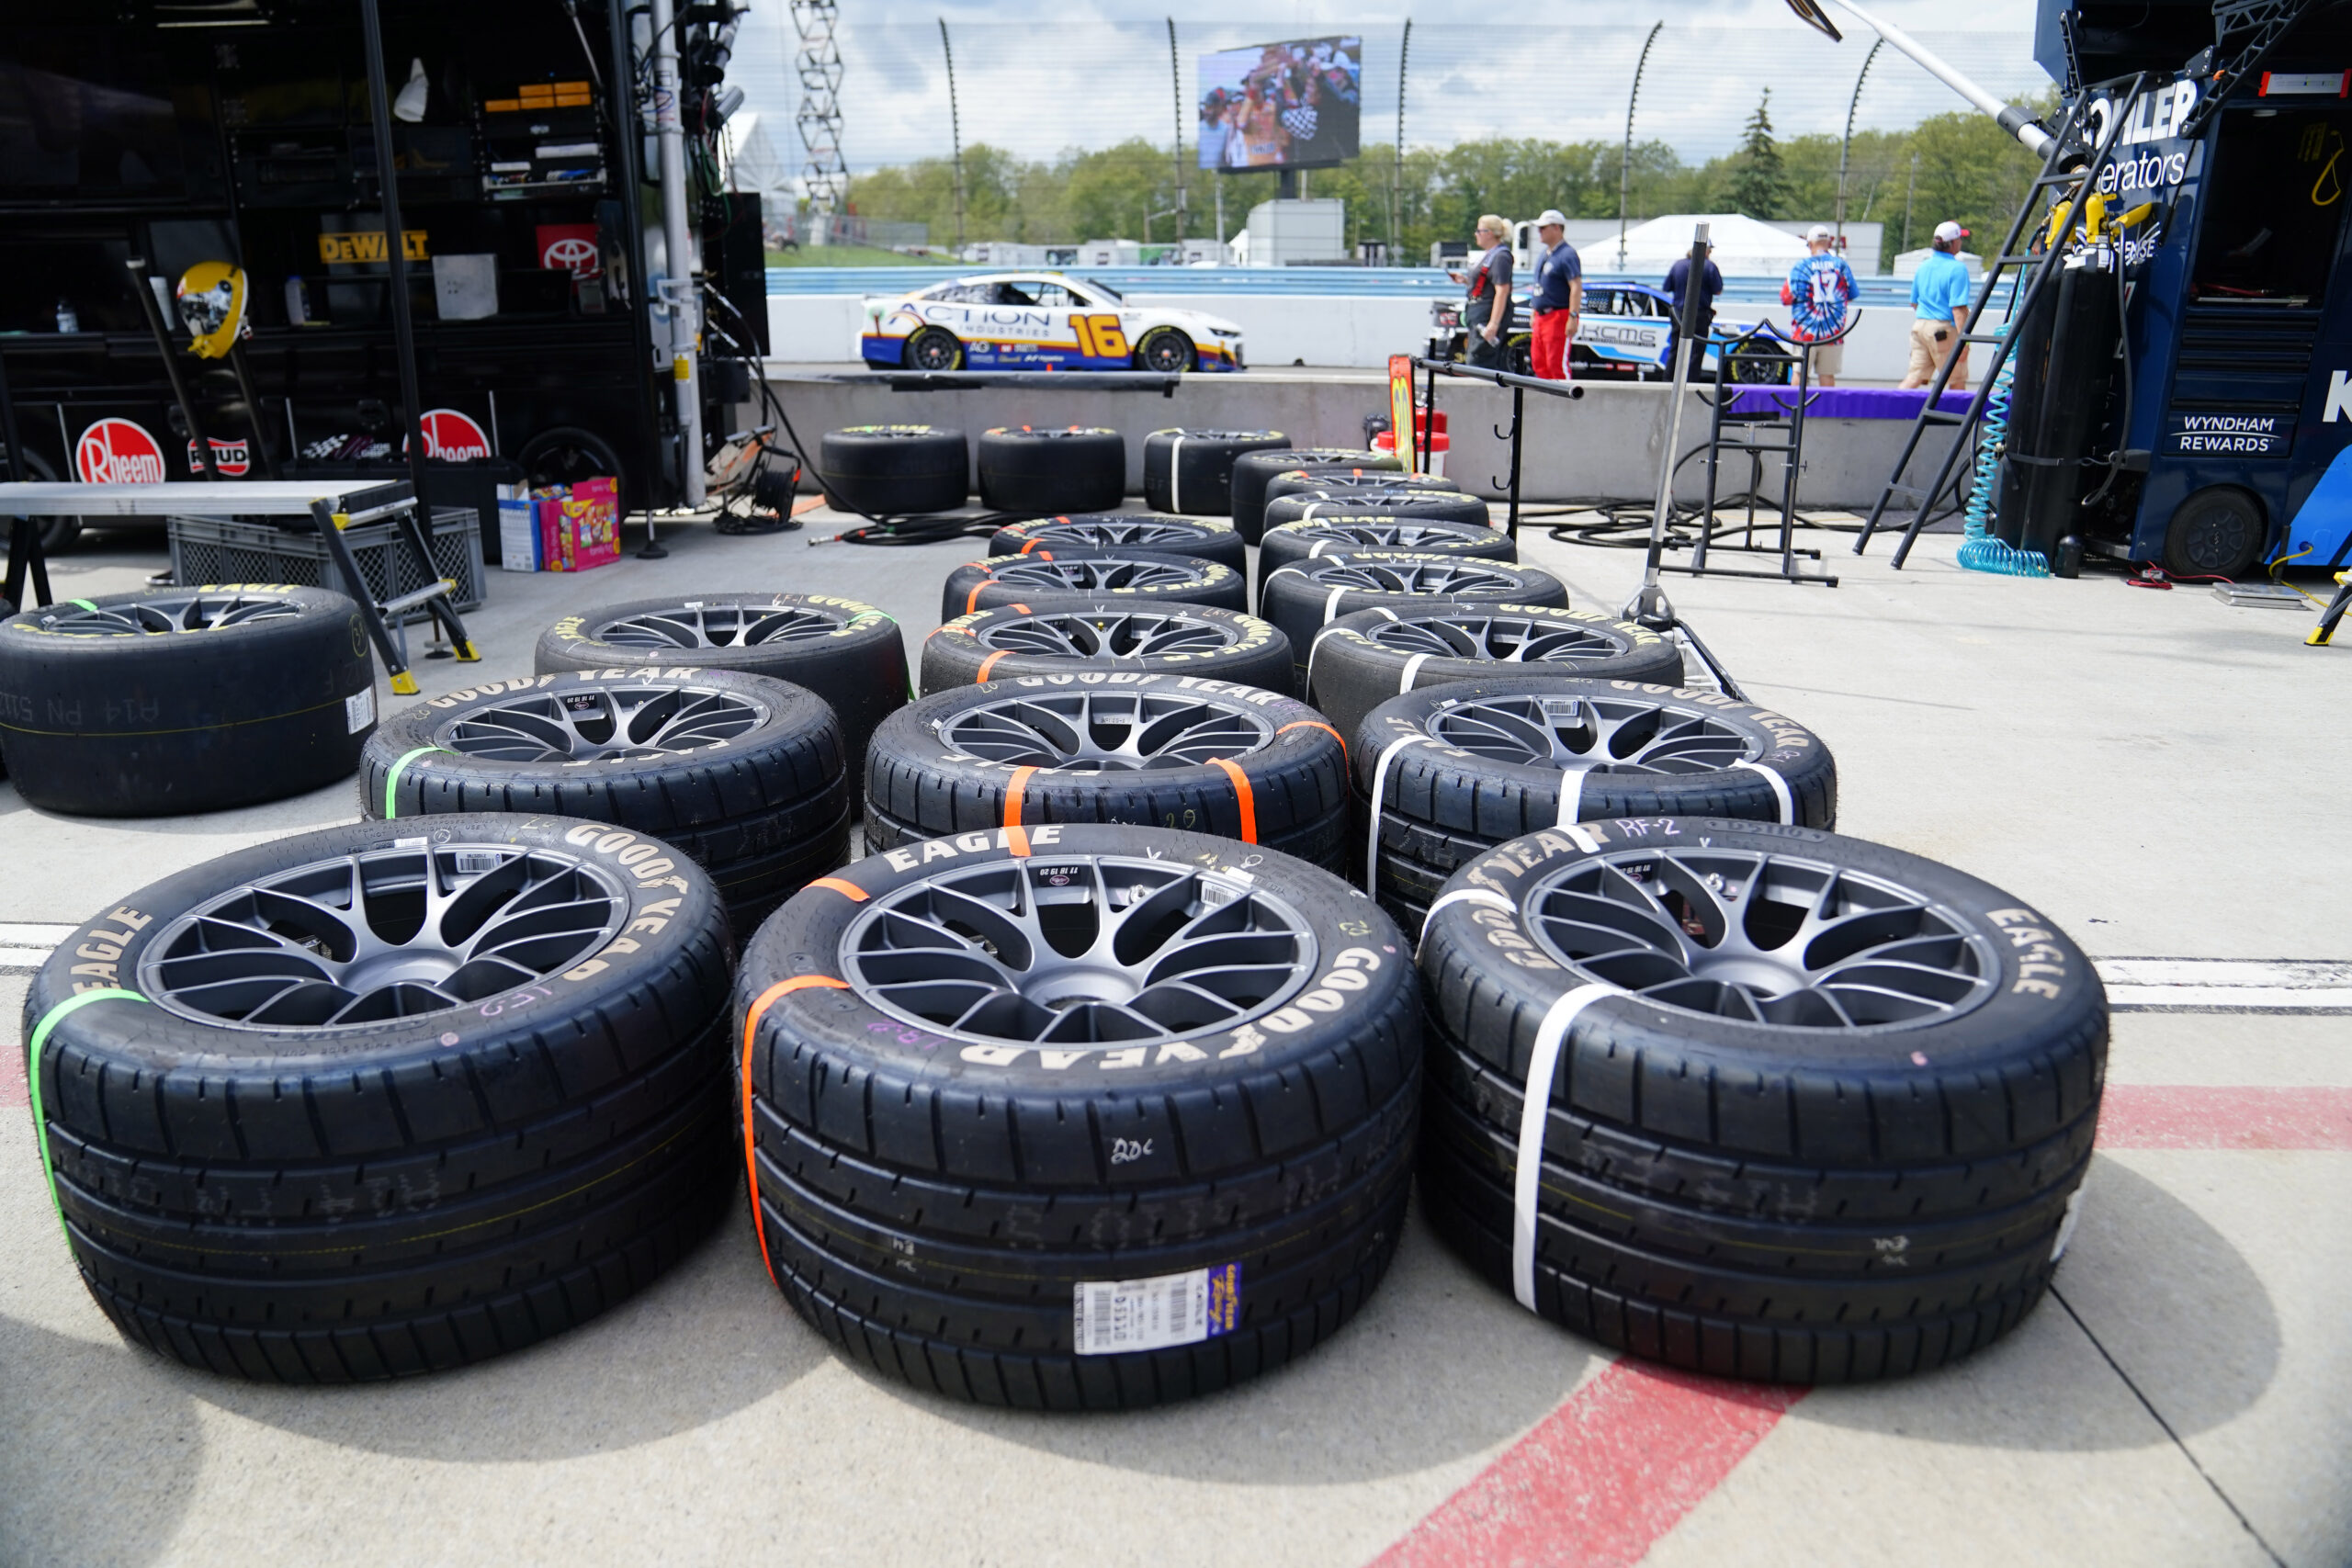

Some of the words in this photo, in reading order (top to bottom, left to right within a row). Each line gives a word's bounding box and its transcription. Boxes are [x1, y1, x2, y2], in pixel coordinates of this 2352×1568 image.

[2098, 151, 2186, 193] erators
[1811, 261, 1834, 270] ALLEN
[1811, 271, 1838, 303] 17
[889, 302, 1050, 326] ACTION
[959, 324, 1050, 337] INDUSTRIES
[1069, 314, 1129, 358] 16
[1582, 325, 1657, 343] KCMG
[2184, 416, 2274, 432] WYNDHAM
[2179, 436, 2269, 452] REWARDS
[188, 445, 247, 465] RUD
[198, 583, 302, 594] EAGLE
[1615, 818, 1680, 838] RF-2
[71, 904, 153, 990] EAGLE
[1986, 908, 2066, 1000] EAGLE
